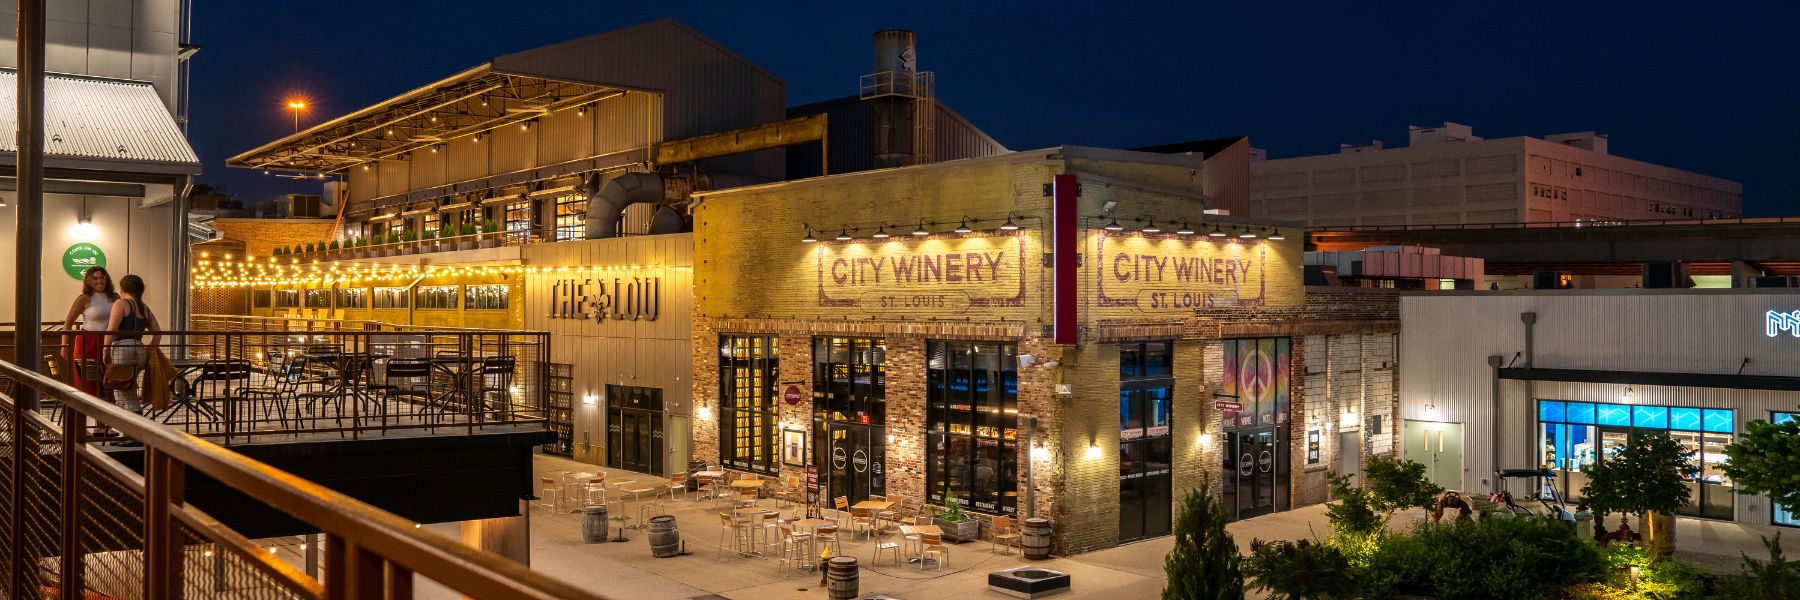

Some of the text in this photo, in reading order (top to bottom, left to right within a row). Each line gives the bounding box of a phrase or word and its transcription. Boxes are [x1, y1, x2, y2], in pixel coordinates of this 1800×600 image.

[831, 251, 1005, 285] CITY WINERY
[1113, 252, 1252, 284] CITY WINERY
[547, 276, 660, 321] THE LOU
[881, 295, 945, 308] ST. LOUIS
[1151, 292, 1215, 309] ST. LOUIS
